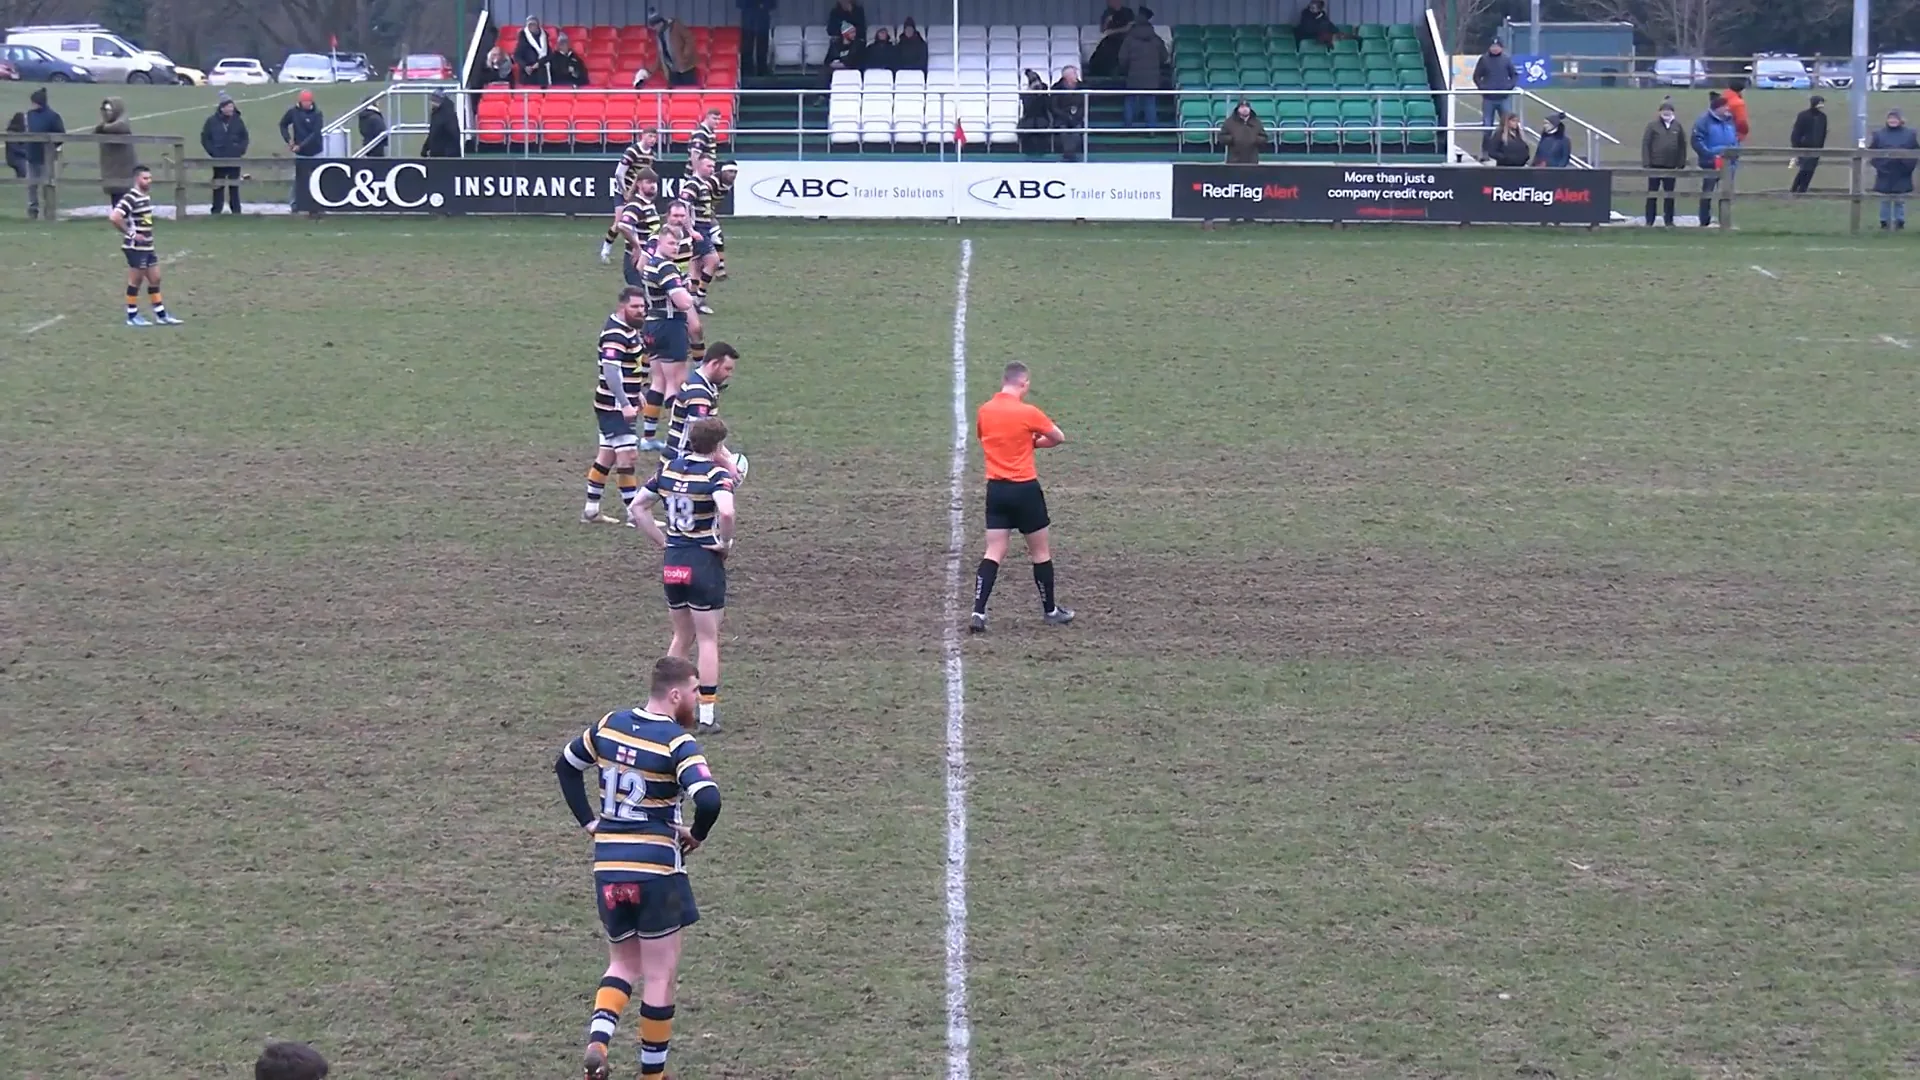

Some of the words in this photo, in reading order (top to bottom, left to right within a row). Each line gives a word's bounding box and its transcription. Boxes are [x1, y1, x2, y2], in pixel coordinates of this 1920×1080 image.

[454, 176, 596, 197] INSURANCE
[776, 178, 850, 198] ABC
[853, 187, 888, 198] Trailer
[893, 187, 944, 199] Solutions
[1344, 171, 1374, 183] More
[1376, 172, 1402, 184] than
[1403, 172, 1426, 186] just
[1427, 175, 1435, 184] a
[993, 180, 1066, 199] ABC
[1071, 188, 1106, 199] Trailer
[1110, 188, 1162, 200] Solutions
[1202, 183, 1298, 202] RedFlagAlert
[1327, 189, 1380, 201] company
[1382, 187, 1416, 199] credit
[1418, 189, 1454, 201] report
[1492, 187, 1590, 205] RedFlagAlert
[666, 494, 695, 532] 13
[602, 765, 648, 821] 12
